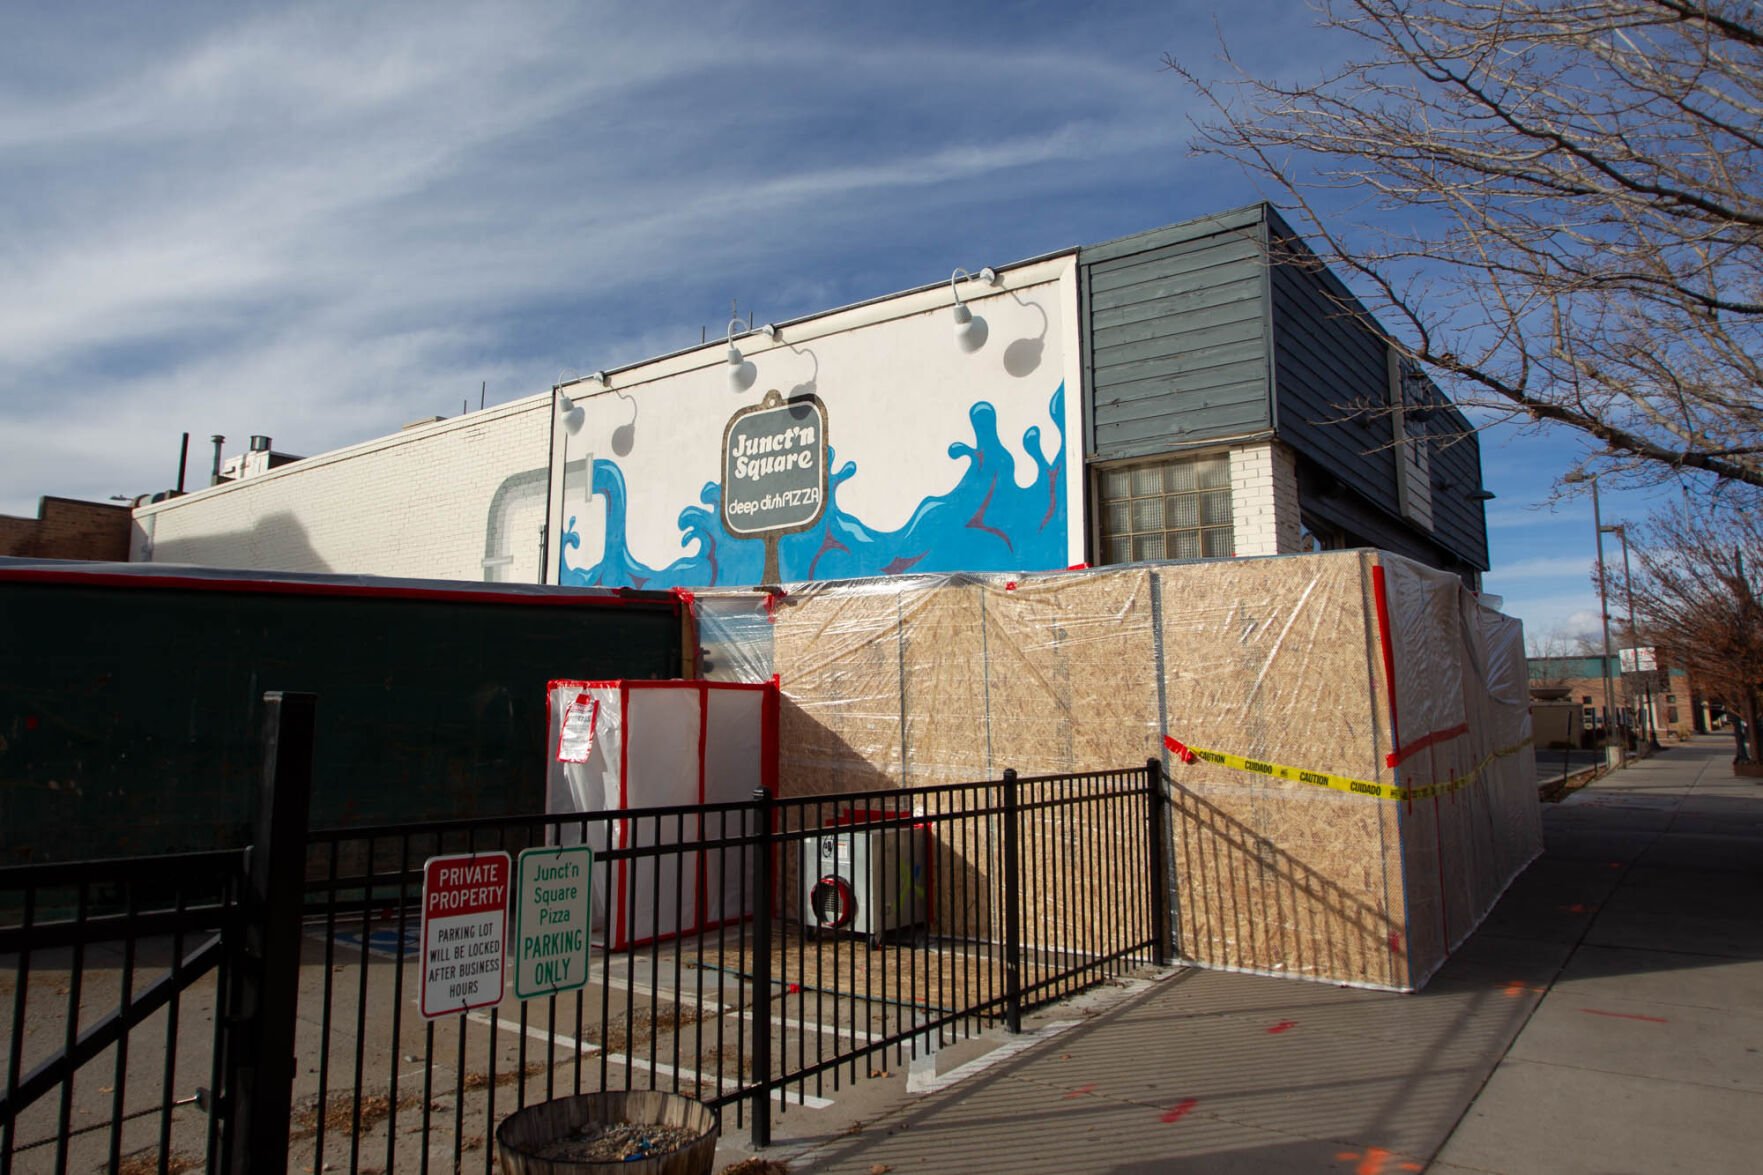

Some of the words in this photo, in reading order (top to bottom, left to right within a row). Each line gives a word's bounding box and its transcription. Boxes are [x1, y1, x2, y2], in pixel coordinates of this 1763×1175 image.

[732, 426, 815, 458] Junct'n
[735, 450, 813, 481] Square
[729, 499, 759, 515] deep
[1199, 751, 1225, 764] CAUTION
[1244, 760, 1273, 774] CUIDADO
[1299, 772, 1329, 786] CAUTION
[1350, 782, 1381, 796] CUIDADO
[439, 864, 498, 887] PRIVATE
[534, 862, 579, 882] Junct'n
[429, 885, 504, 912] PROPERTY
[534, 887, 577, 906] Square
[540, 908, 570, 926] Pizza
[438, 925, 475, 943] PARKING
[479, 922, 494, 936] LOT
[430, 949, 450, 963] WILL
[454, 946, 465, 960] BE
[468, 940, 500, 957] LOCKED
[524, 929, 582, 960] PARKING
[428, 966, 456, 983] AFTER
[459, 958, 500, 977] BUSINESS
[535, 958, 572, 985] ONLY
[450, 981, 478, 998] HOURS
